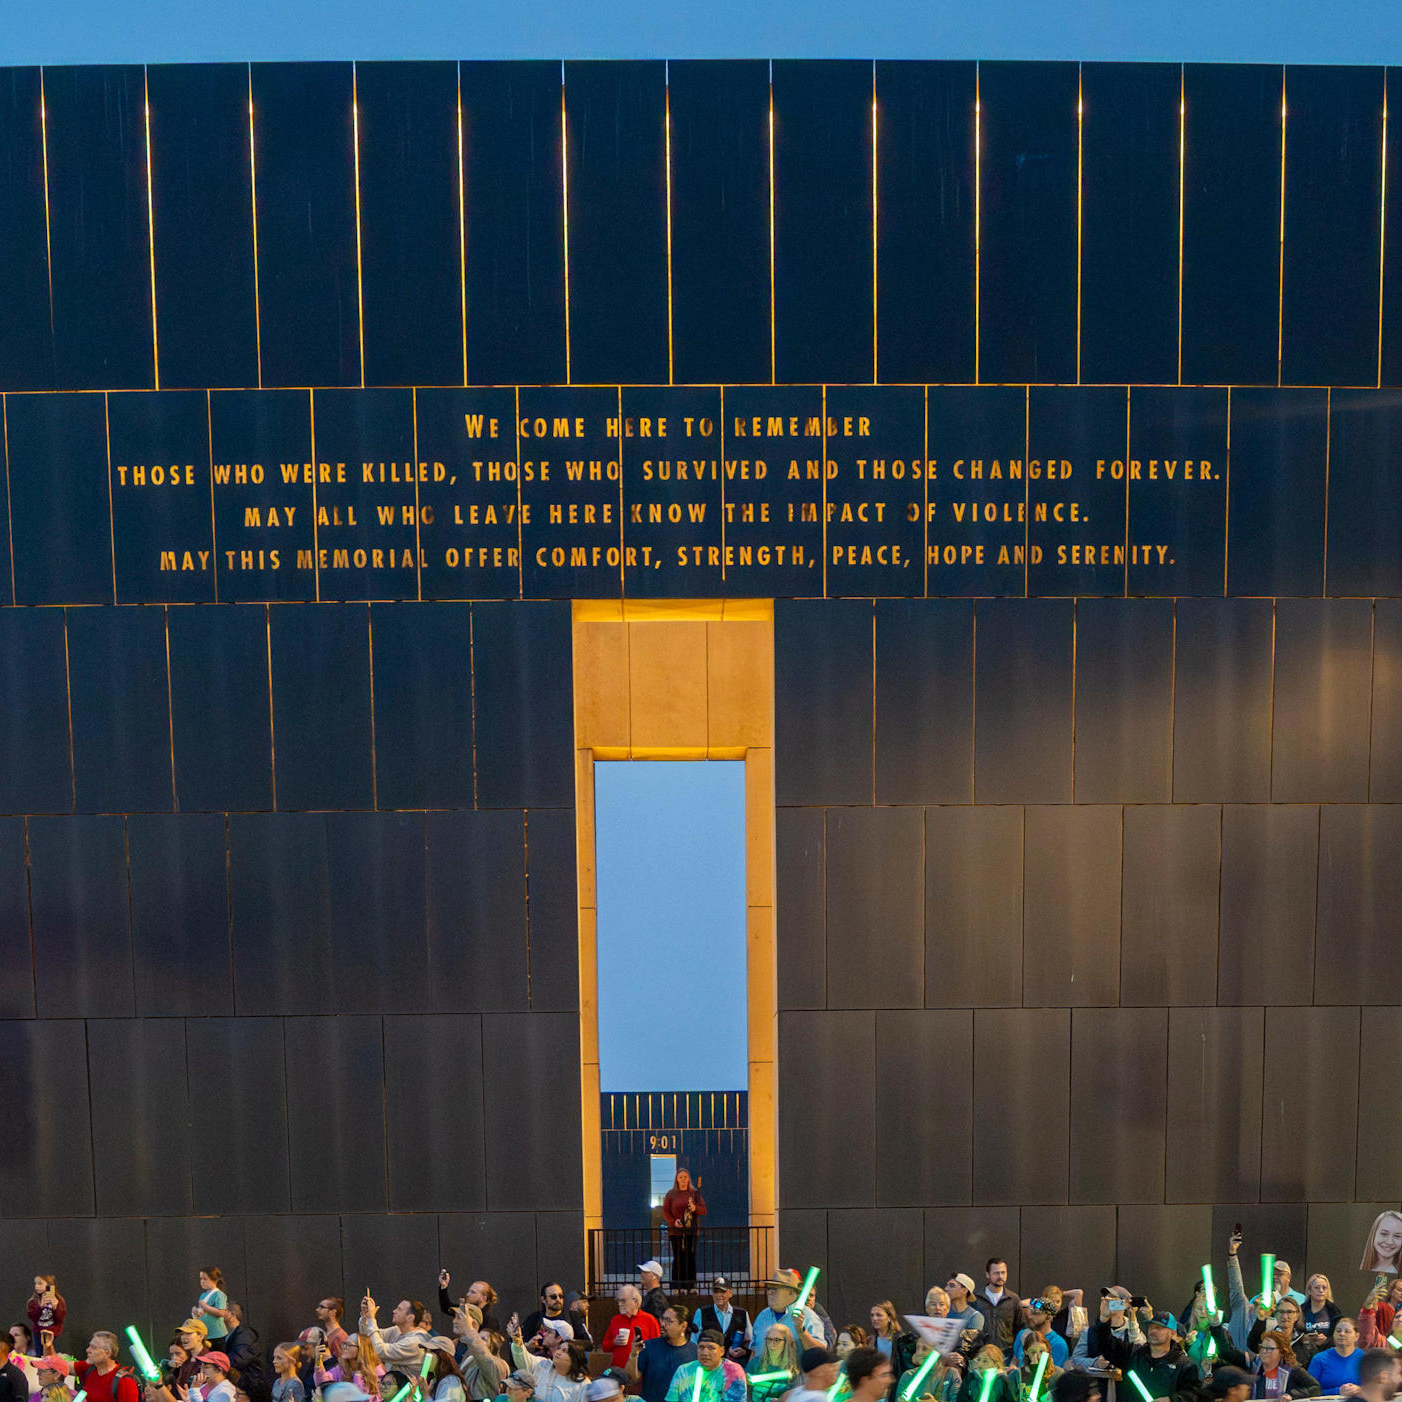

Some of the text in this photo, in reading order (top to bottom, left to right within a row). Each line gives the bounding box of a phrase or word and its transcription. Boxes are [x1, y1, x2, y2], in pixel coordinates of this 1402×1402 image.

[520, 417, 586, 438] COME
[606, 416, 667, 438] HERE
[683, 416, 714, 438] TO
[734, 416, 872, 437] REMEMBER
[117, 459, 1221, 486] THOSE WHO WERE KILLED, THOSE WHO SURVIVED AND THOSE CHANGED FOREVER.
[244, 502, 1090, 528] MAY ALL WHO LEAVE HERE KNOW THE IMPACT OF VIOLENCE.
[159, 545, 1176, 572] MAY THIS MEMORIAL OFFER COMFORT, STRENGTH, PEACE, HOPE AND SERENITY.
[649, 1134, 677, 1151] 9:01
